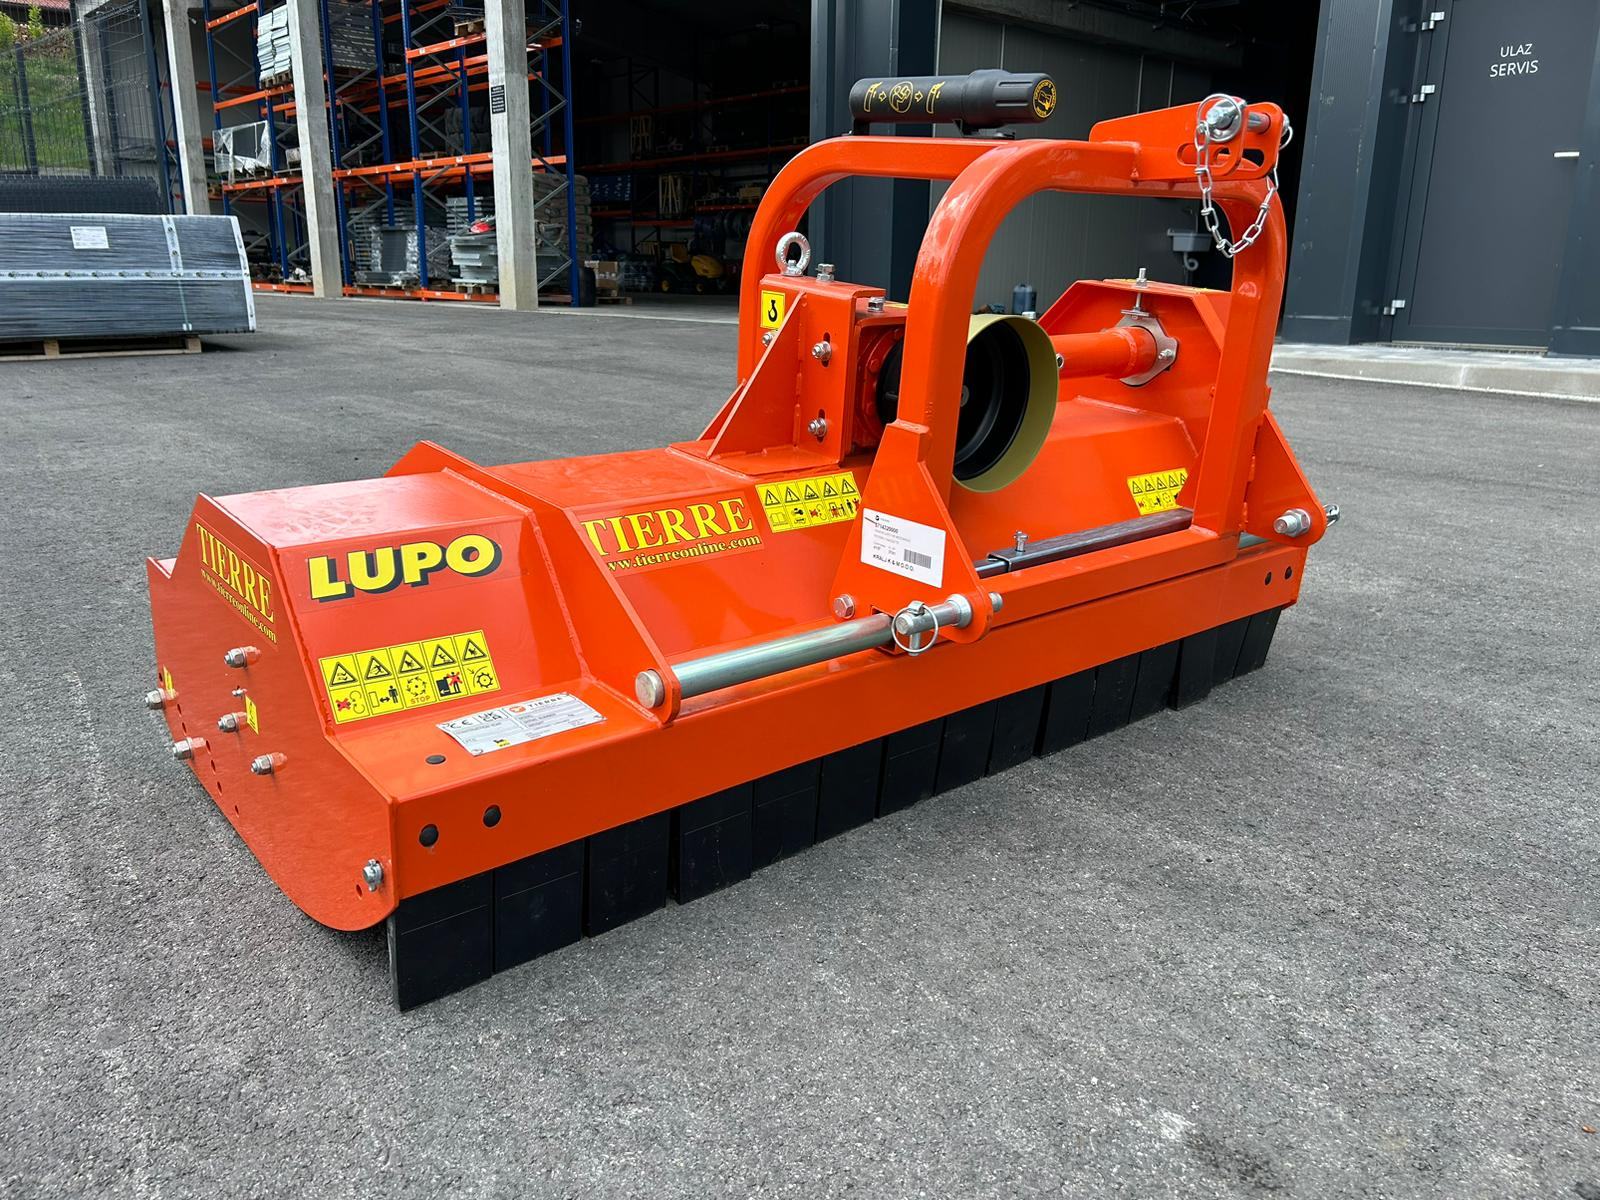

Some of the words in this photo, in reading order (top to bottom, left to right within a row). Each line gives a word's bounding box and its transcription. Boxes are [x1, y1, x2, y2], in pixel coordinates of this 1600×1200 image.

[1489, 60, 1539, 77] SERVIS
[1500, 43, 1532, 58] ULAZ
[581, 498, 753, 556] TIERRE
[308, 534, 502, 603] LUPO
[607, 535, 761, 571] ww.tierreonline.com
[196, 522, 274, 624] TIERRE
[410, 695, 431, 705] STOP
